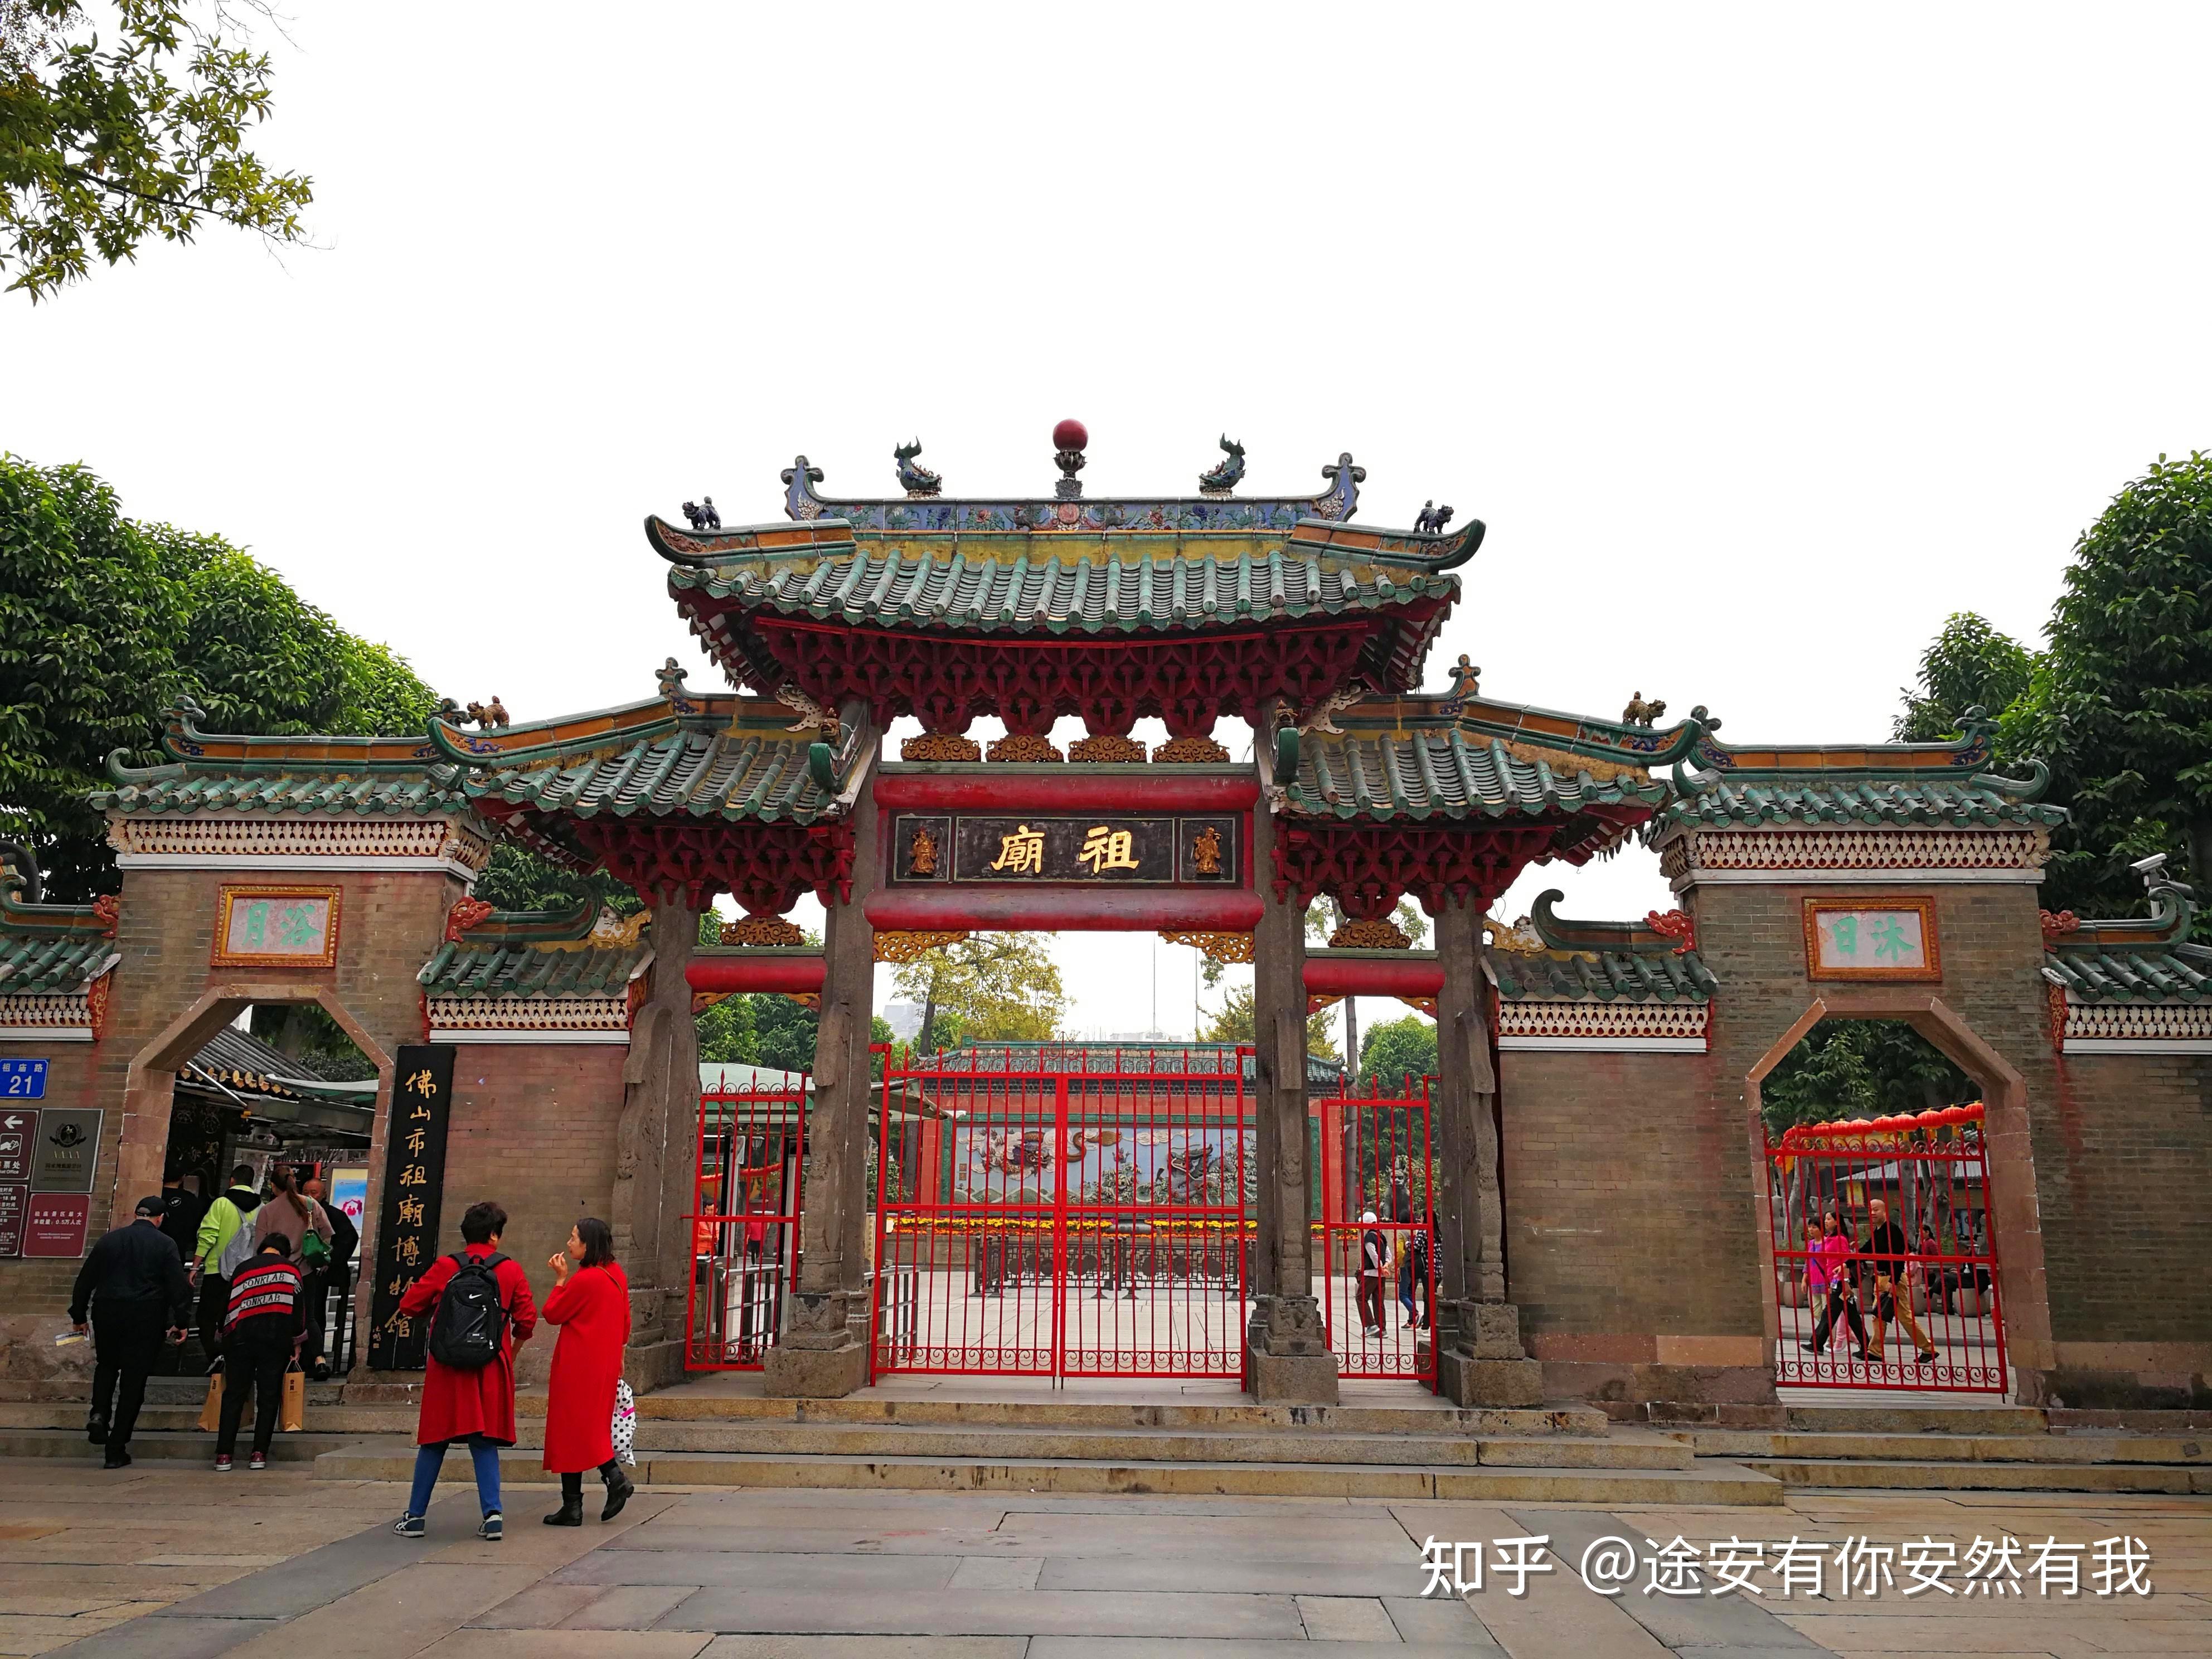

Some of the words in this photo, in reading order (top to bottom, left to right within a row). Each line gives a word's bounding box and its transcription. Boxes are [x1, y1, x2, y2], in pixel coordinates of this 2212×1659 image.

[991, 825, 1139, 874] 祖廟
[1832, 916, 1915, 961] 沐日
[2, 1063, 43, 1073] 祖庙路
[8, 1075, 32, 1094] 21
[242, 1273, 285, 1289] CONKLAB
[240, 1294, 280, 1309] CONKLAB
